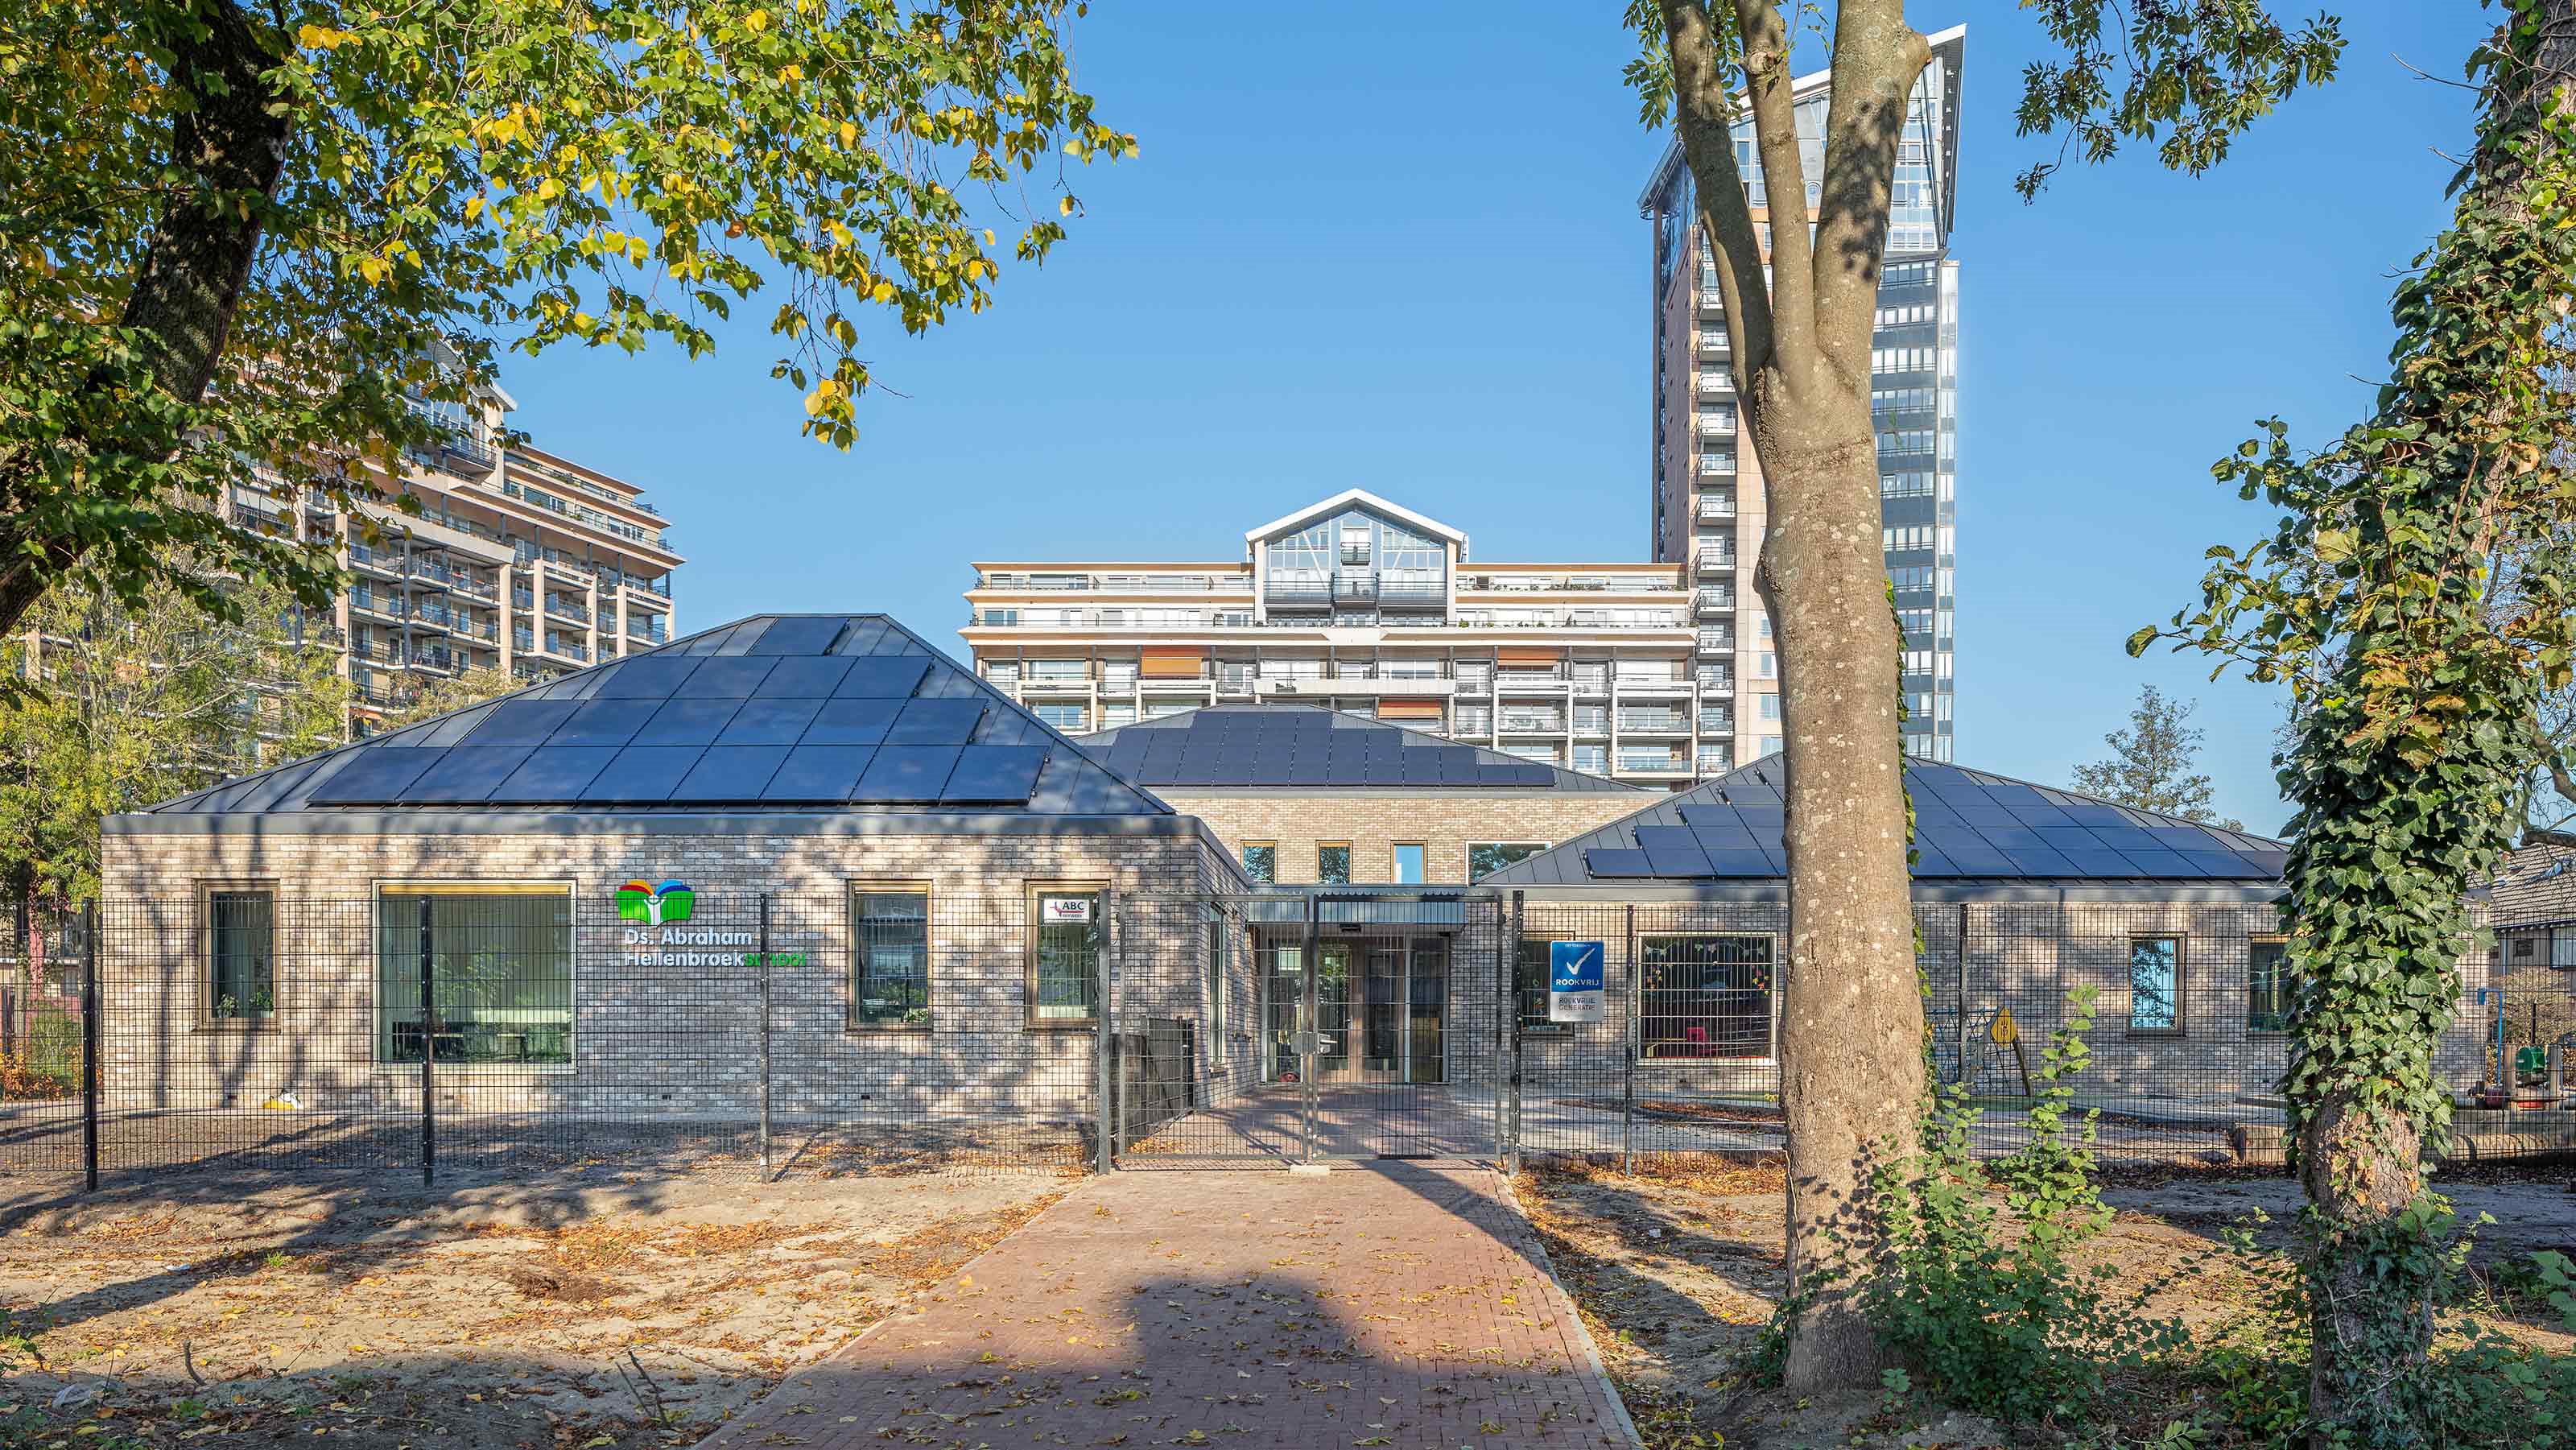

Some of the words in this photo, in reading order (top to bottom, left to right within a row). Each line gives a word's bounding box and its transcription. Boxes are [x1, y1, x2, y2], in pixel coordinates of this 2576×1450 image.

[1063, 902, 1084, 910] ABC
[625, 928, 655, 945] Ds.
[661, 927, 753, 945] Abraham
[1555, 978, 1599, 986] ROOKVRIJ
